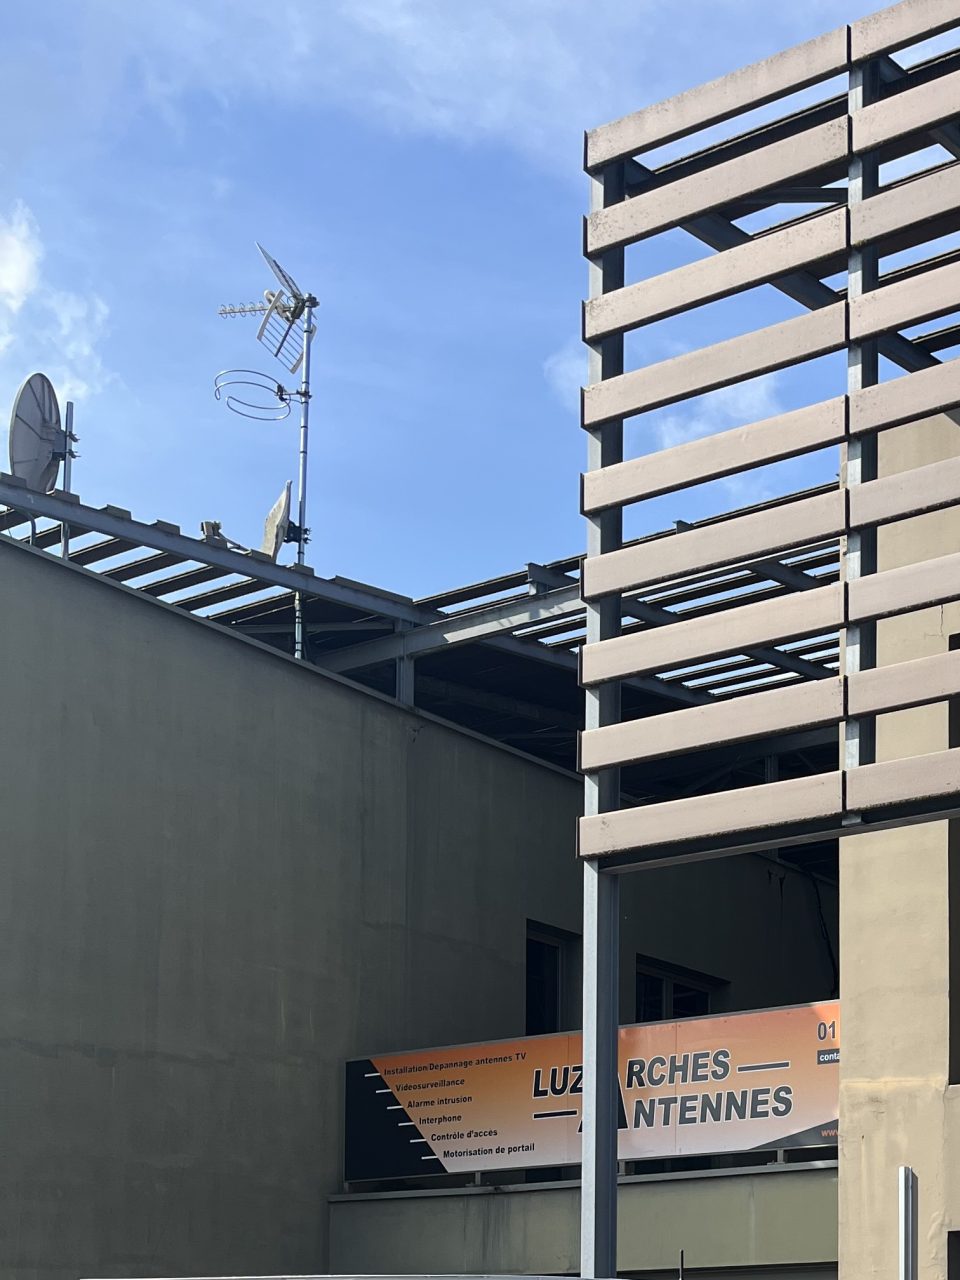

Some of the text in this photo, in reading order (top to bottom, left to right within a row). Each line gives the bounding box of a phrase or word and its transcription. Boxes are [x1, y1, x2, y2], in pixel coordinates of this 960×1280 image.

[817, 1021, 836, 1040] 01
[475, 1055, 512, 1065] antennes
[515, 1052, 527, 1061] TV
[407, 1095, 473, 1109] Alarme intrusion
[419, 1114, 462, 1126] Interphone
[431, 1129, 464, 1142] Contrôle
[443, 1143, 535, 1158] Motorisation de portail
